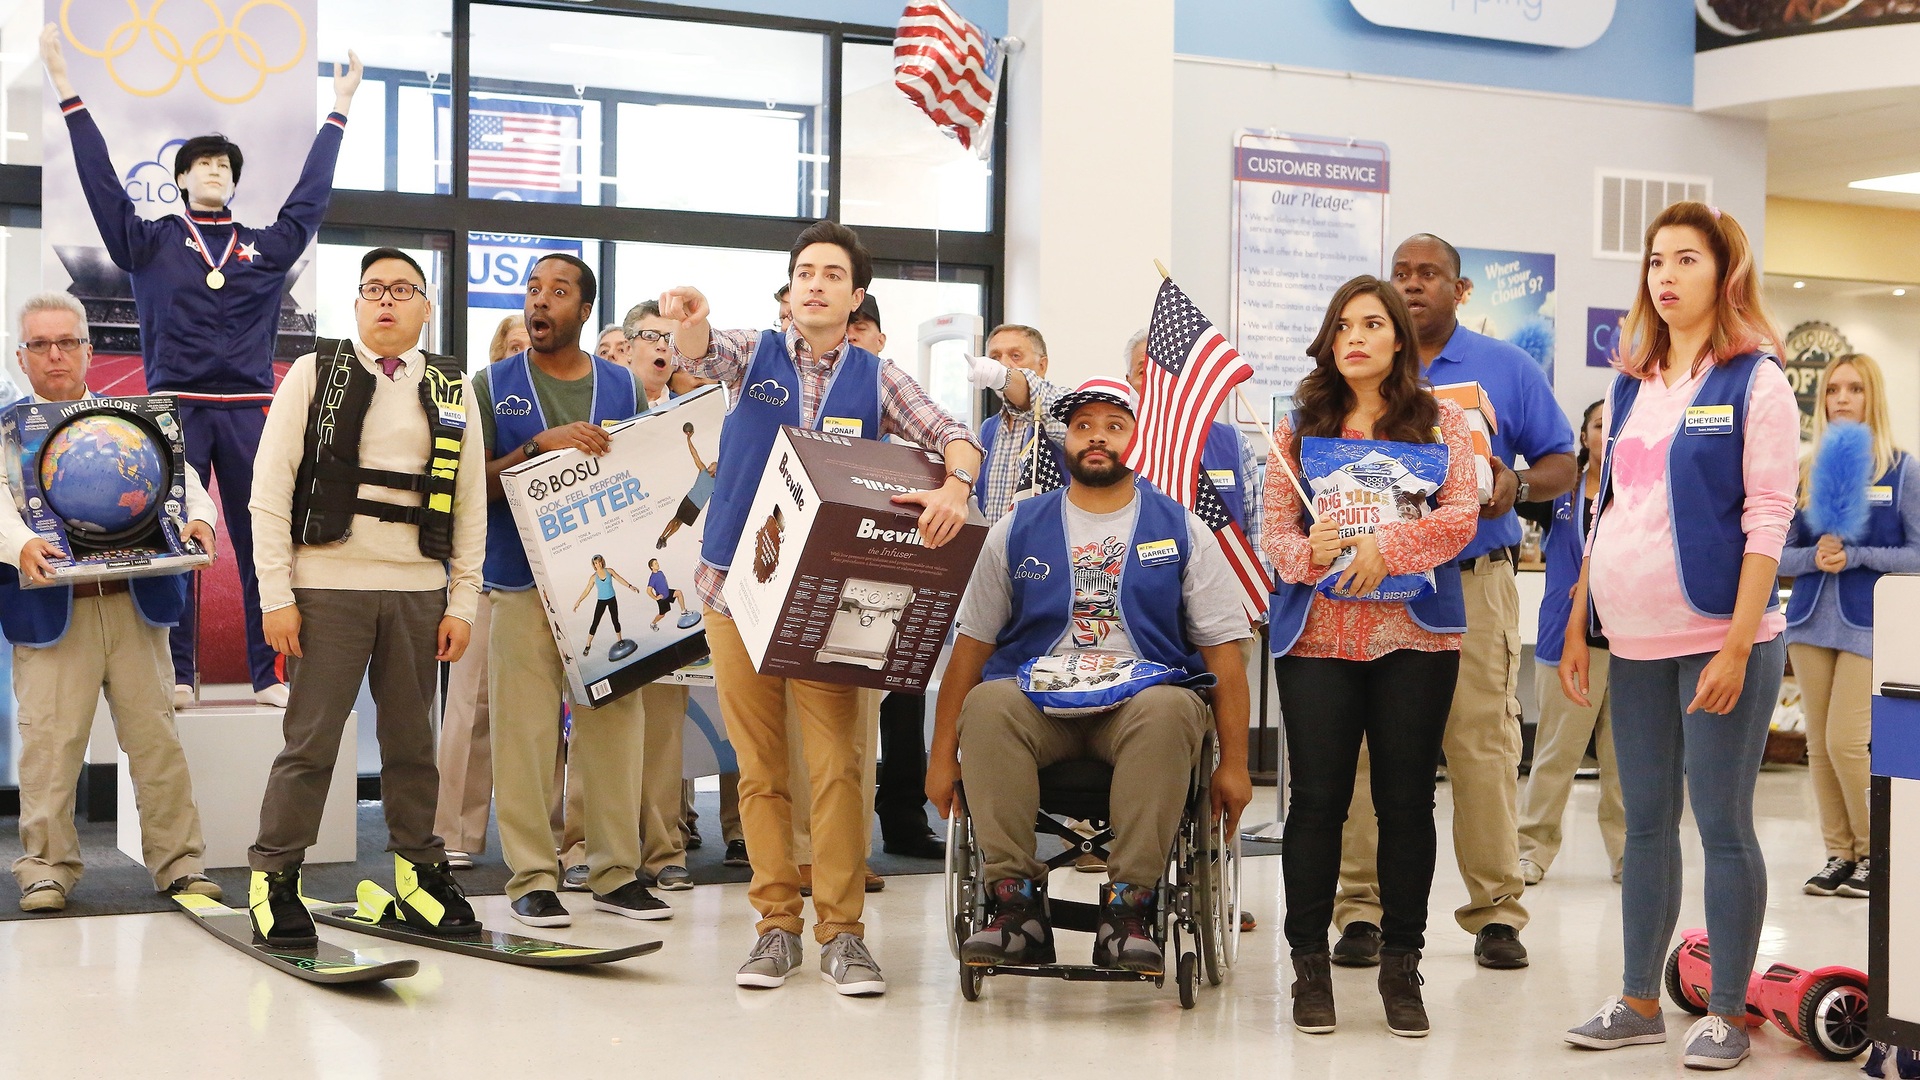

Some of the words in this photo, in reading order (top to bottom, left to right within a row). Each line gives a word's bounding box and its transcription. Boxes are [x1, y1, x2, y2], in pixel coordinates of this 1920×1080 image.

[1248, 157, 1321, 177] CUSTOMER
[1325, 164, 1376, 183] SERVICE
[125, 180, 178, 203] CLO
[1271, 190, 1298, 206] Our
[1301, 192, 1354, 212] Pledge:
[1250, 213, 1261, 221] We
[1249, 225, 1272, 234] service
[1274, 228, 1310, 237] experience
[1312, 230, 1339, 239] possible
[1249, 246, 1261, 254] We
[1263, 247, 1275, 255] will
[1276, 248, 1291, 256] offer
[1293, 248, 1303, 257] the
[1305, 250, 1319, 258] best
[1320, 251, 1347, 261] possible
[1348, 254, 1368, 263] prices
[1248, 267, 1261, 275] We
[1262, 268, 1274, 276] will
[1276, 269, 1299, 279] always
[1301, 269, 1310, 278] be
[1485, 260, 1520, 280] Where
[1248, 279, 1254, 287] to
[1256, 279, 1283, 288] address
[1285, 281, 1317, 291] comments
[1497, 277, 1506, 289] is
[1507, 269, 1531, 288] your
[1491, 282, 1526, 305] Cloud
[1528, 275, 1543, 294] 9?
[1248, 300, 1260, 309] We
[1262, 301, 1273, 309] will
[1248, 321, 1260, 329] We
[1275, 322, 1290, 330] offer
[1292, 323, 1303, 332] the
[1304, 324, 1317, 332] best
[1248, 335, 1284, 343] experience
[1247, 351, 1259, 359] We
[1274, 353, 1296, 361] ensure
[1255, 363, 1263, 371] all
[1265, 364, 1279, 372] with
[1281, 365, 1305, 374] special
[1270, 379, 1282, 387] you
[1282, 379, 1293, 387] for
[748, 390, 785, 407] CLOUD9
[60, 399, 138, 417] INTELLIGLOBE
[444, 411, 461, 419] MATEO
[1688, 416, 1730, 424] CHEYENNE
[830, 427, 854, 435] JONAH
[549, 457, 600, 493] BOSU
[779, 452, 804, 512] Breville
[850, 476, 929, 494] reville
[535, 500, 564, 517] LOOK.
[565, 489, 588, 504] FEEL.
[590, 470, 632, 494] PERFORM.
[538, 477, 650, 542] BETTER.
[1318, 492, 1341, 515] DOG
[856, 518, 924, 546] Brevil
[868, 547, 879, 555] the
[880, 547, 914, 559] Infuser
[1142, 548, 1174, 558] GARRETT
[1014, 570, 1047, 581] CLOUD9
